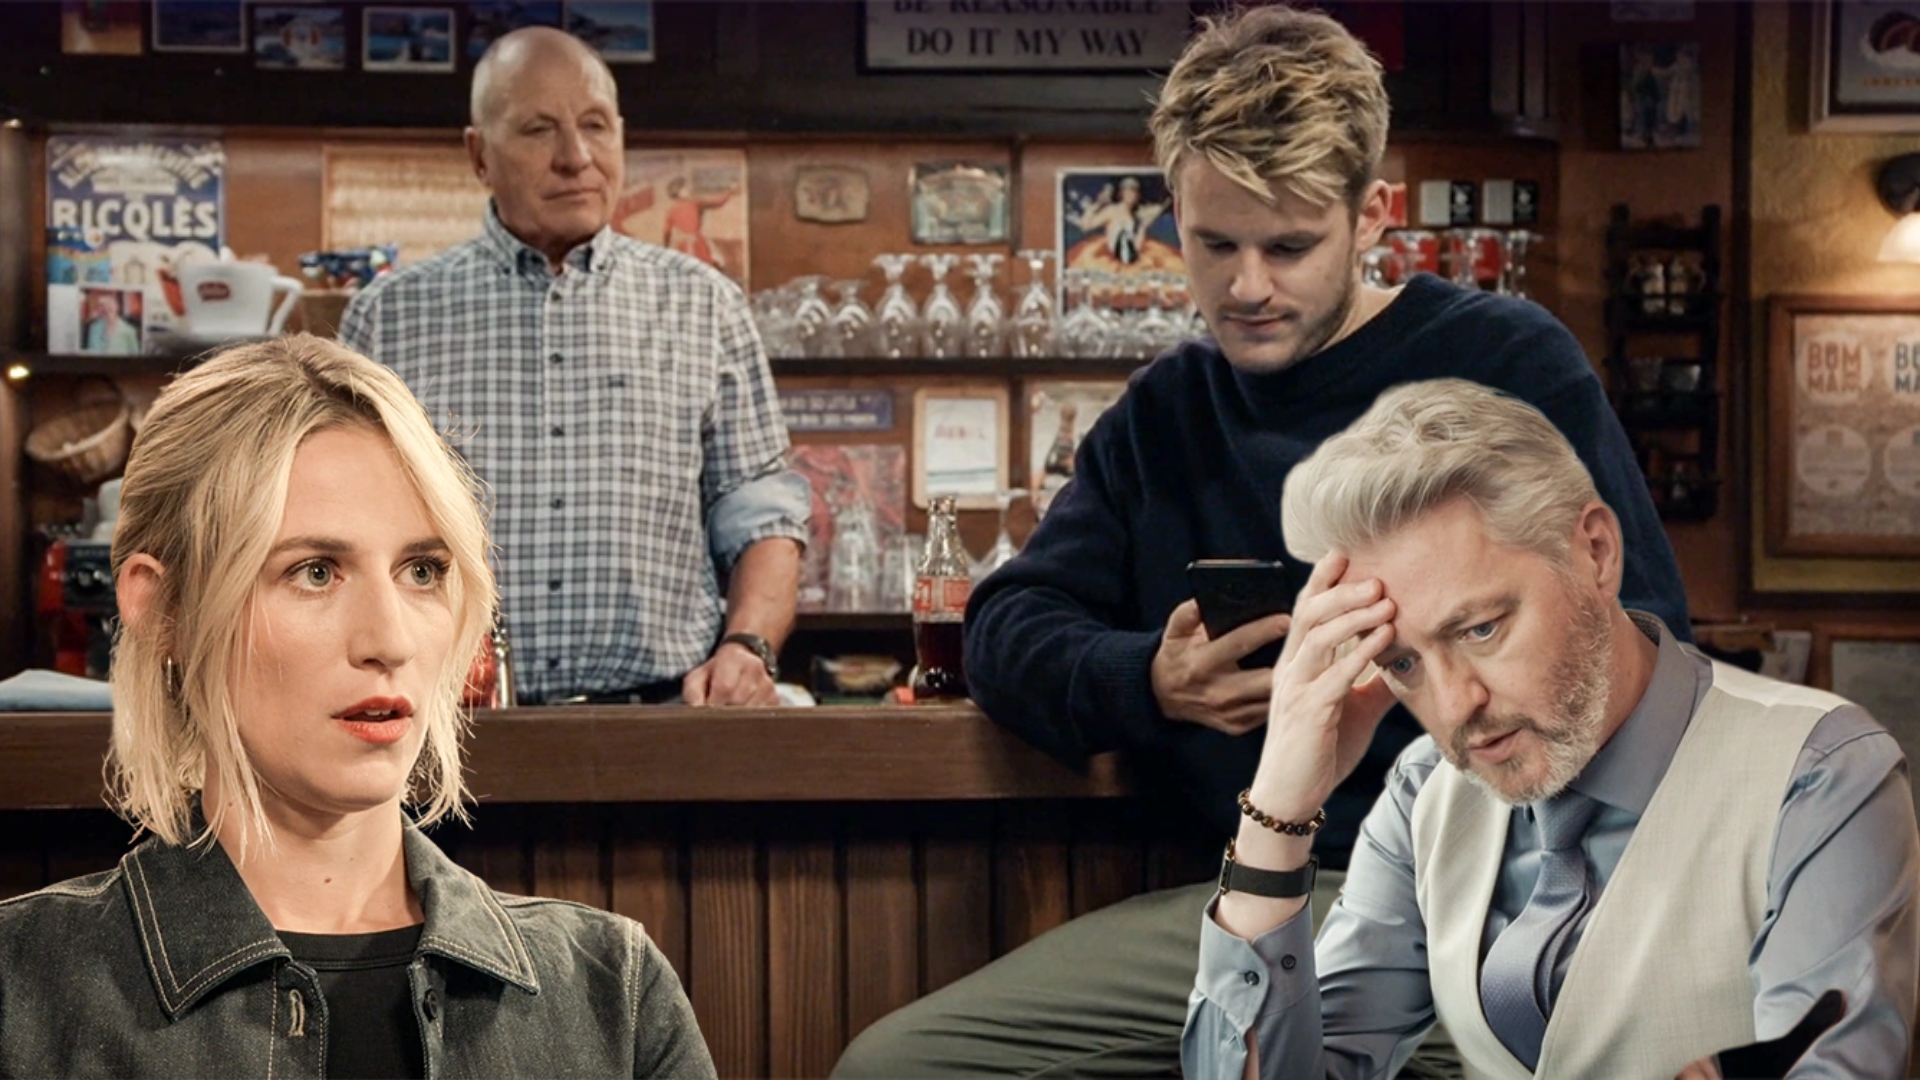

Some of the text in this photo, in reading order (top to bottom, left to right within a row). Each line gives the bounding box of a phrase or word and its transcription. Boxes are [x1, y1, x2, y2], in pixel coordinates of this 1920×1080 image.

[907, 27, 1149, 56] DO IT MY WAY
